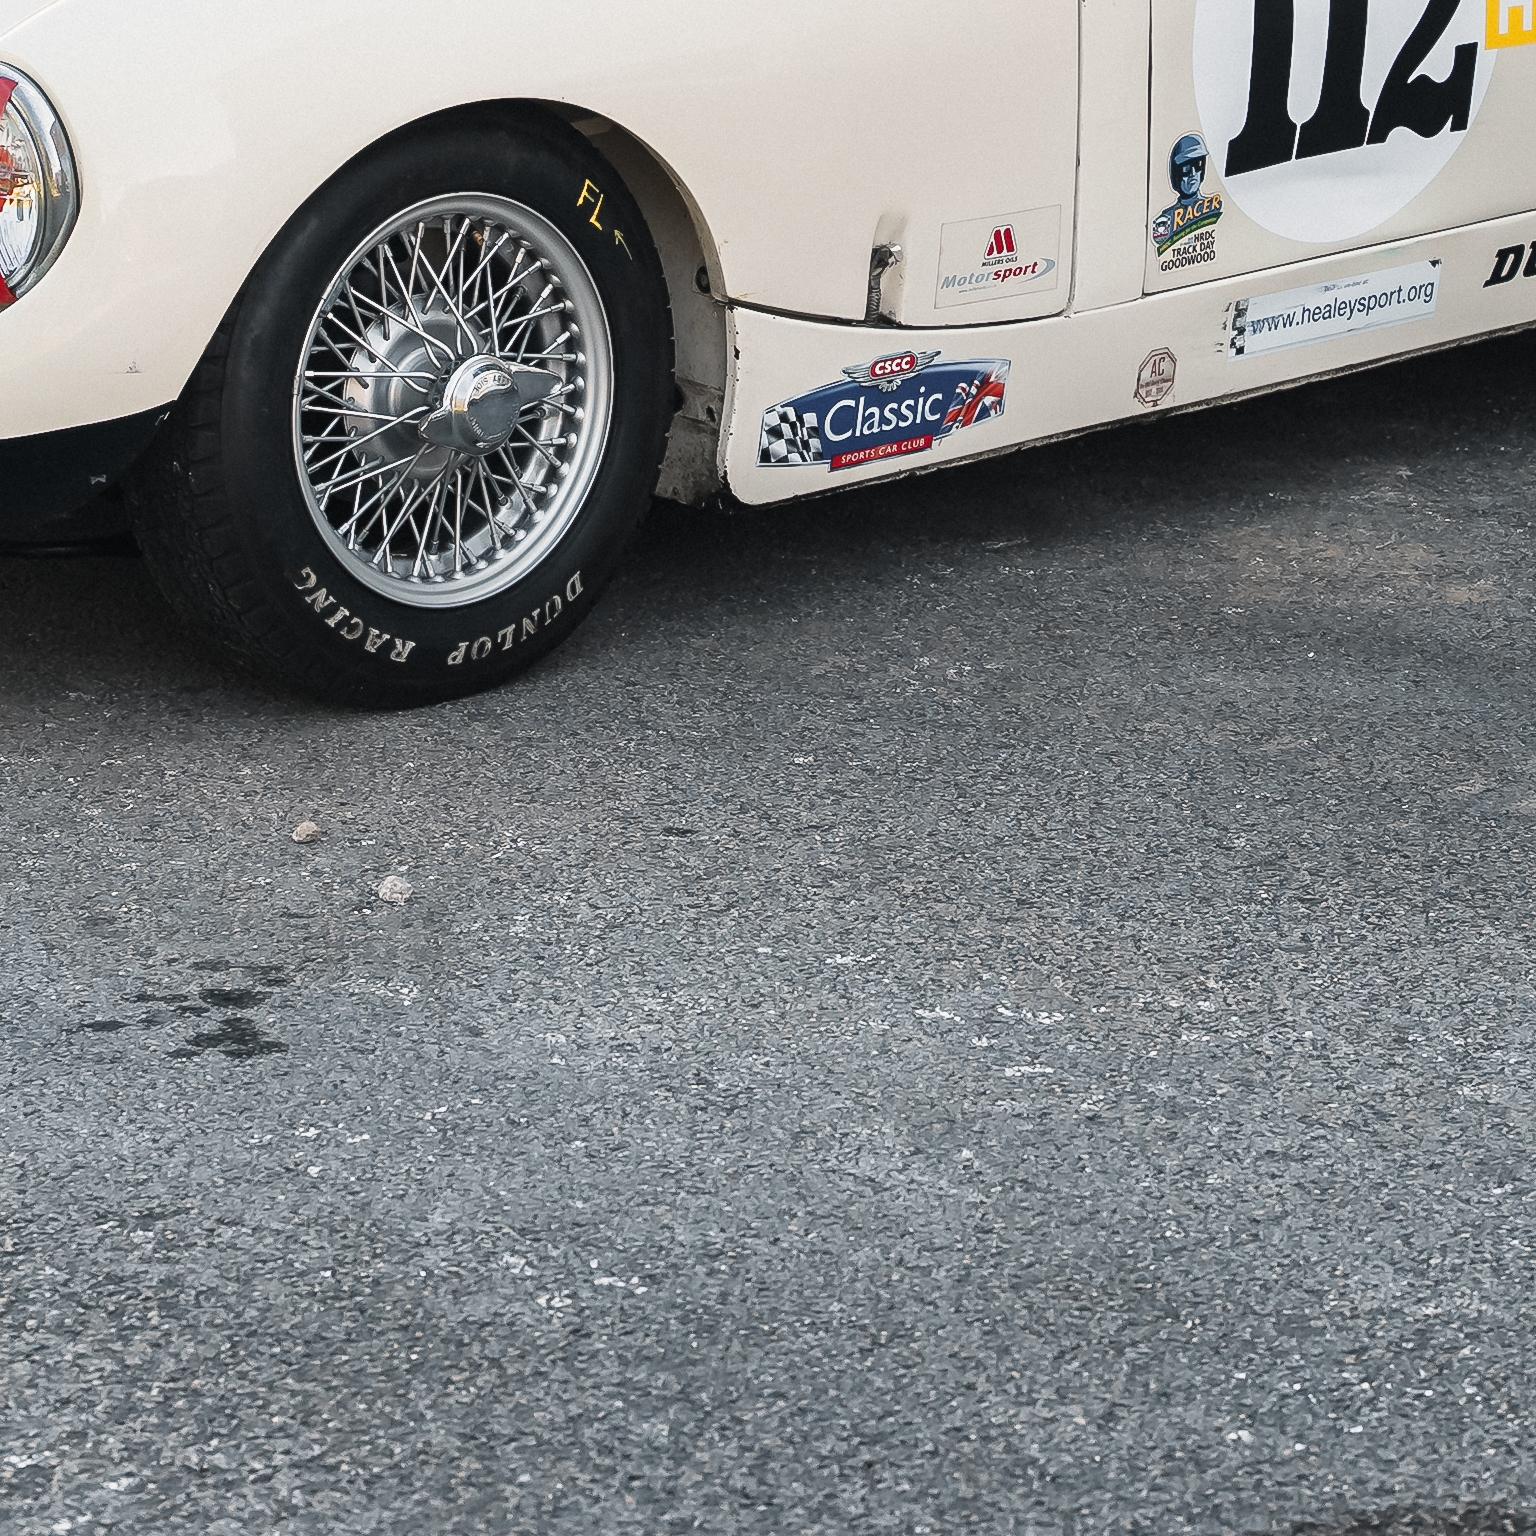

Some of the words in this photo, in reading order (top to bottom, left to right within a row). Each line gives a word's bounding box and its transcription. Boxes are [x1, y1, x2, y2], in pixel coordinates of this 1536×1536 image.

[577, 178, 603, 231] FL
[1173, 195, 1221, 232] RACER
[1172, 245, 1198, 259] TRACK
[1199, 240, 1215, 252] DAY
[1194, 230, 1215, 243] HRDC
[981, 259, 1004, 268] MILLERS
[1005, 256, 1018, 264] OILS
[1161, 250, 1216, 271] GOODWOOD
[940, 262, 1039, 290] Motorsport
[1250, 281, 1435, 337] www.healeysport.org
[875, 357, 911, 375] CSCC
[1150, 356, 1166, 378] AC
[825, 386, 943, 442] Classic
[841, 448, 875, 464] SPORTS
[878, 443, 898, 457] CAR
[901, 437, 925, 452] CLUB
[293, 566, 416, 663] RACING
[447, 571, 583, 666] DUNLOP
